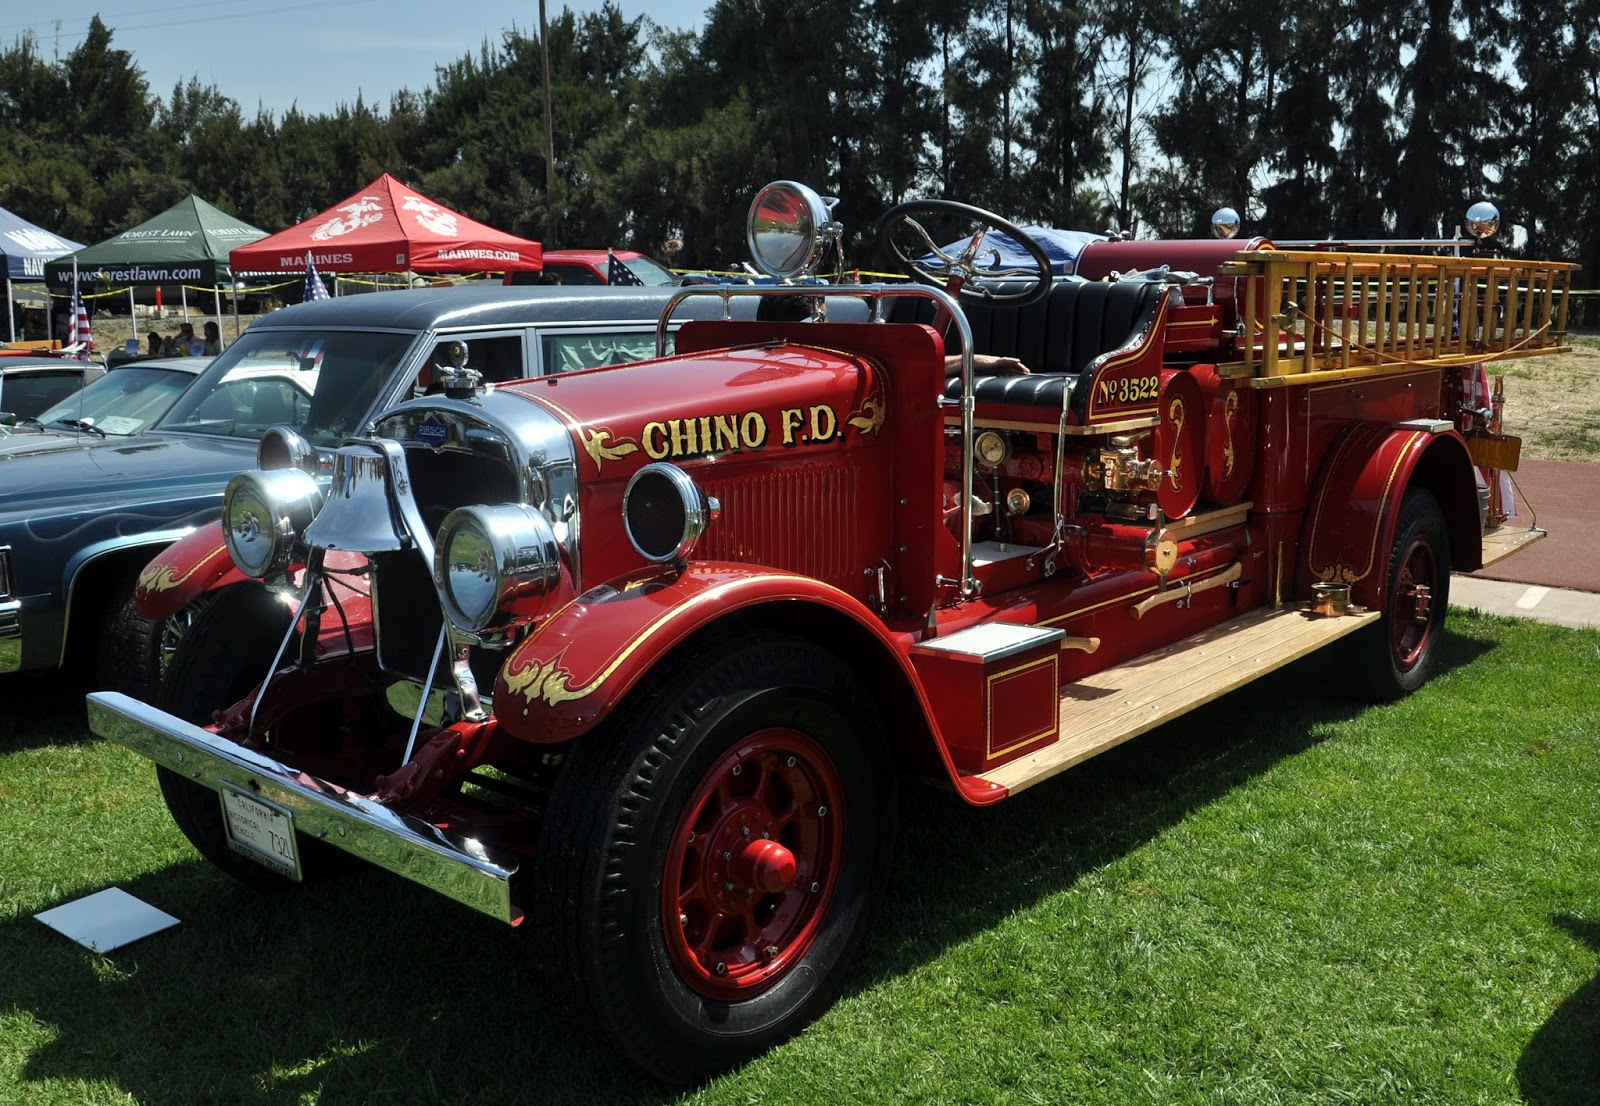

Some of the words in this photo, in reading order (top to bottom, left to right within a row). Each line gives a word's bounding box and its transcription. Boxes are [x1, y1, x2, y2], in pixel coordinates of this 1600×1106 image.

[280, 253, 354, 267] MARINES
[437, 249, 520, 261] MARINES.COM
[1119, 376, 1159, 402] 3522
[418, 425, 446, 436] PIRSCH
[641, 411, 768, 460] CHINO
[781, 404, 843, 444] F.D.
[237, 798, 274, 822] CALIFORNIA
